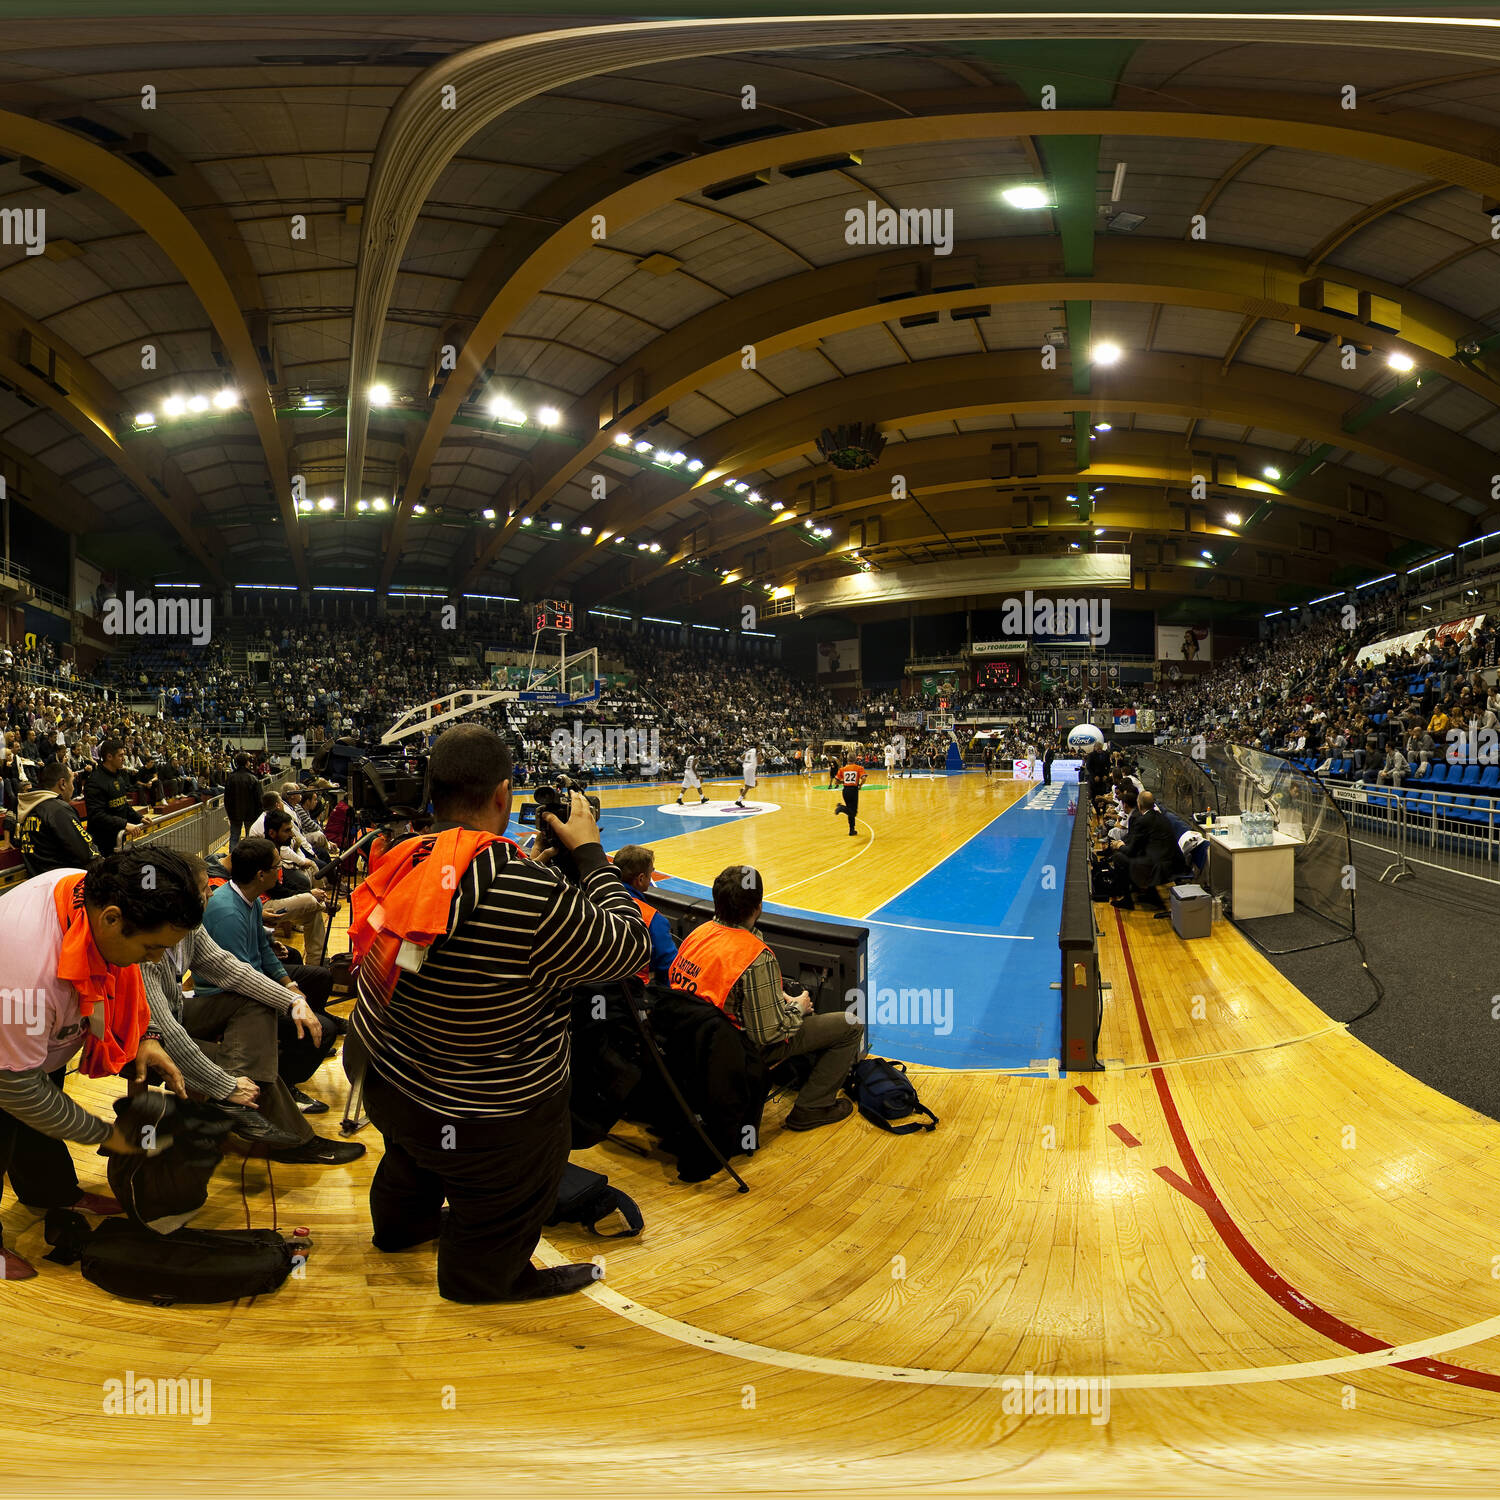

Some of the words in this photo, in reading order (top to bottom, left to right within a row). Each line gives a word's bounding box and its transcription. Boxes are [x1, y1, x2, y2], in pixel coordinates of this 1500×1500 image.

[556, 614, 572, 629] 23
[1070, 736, 1090, 746] Ford
[845, 772, 856, 782] 22
